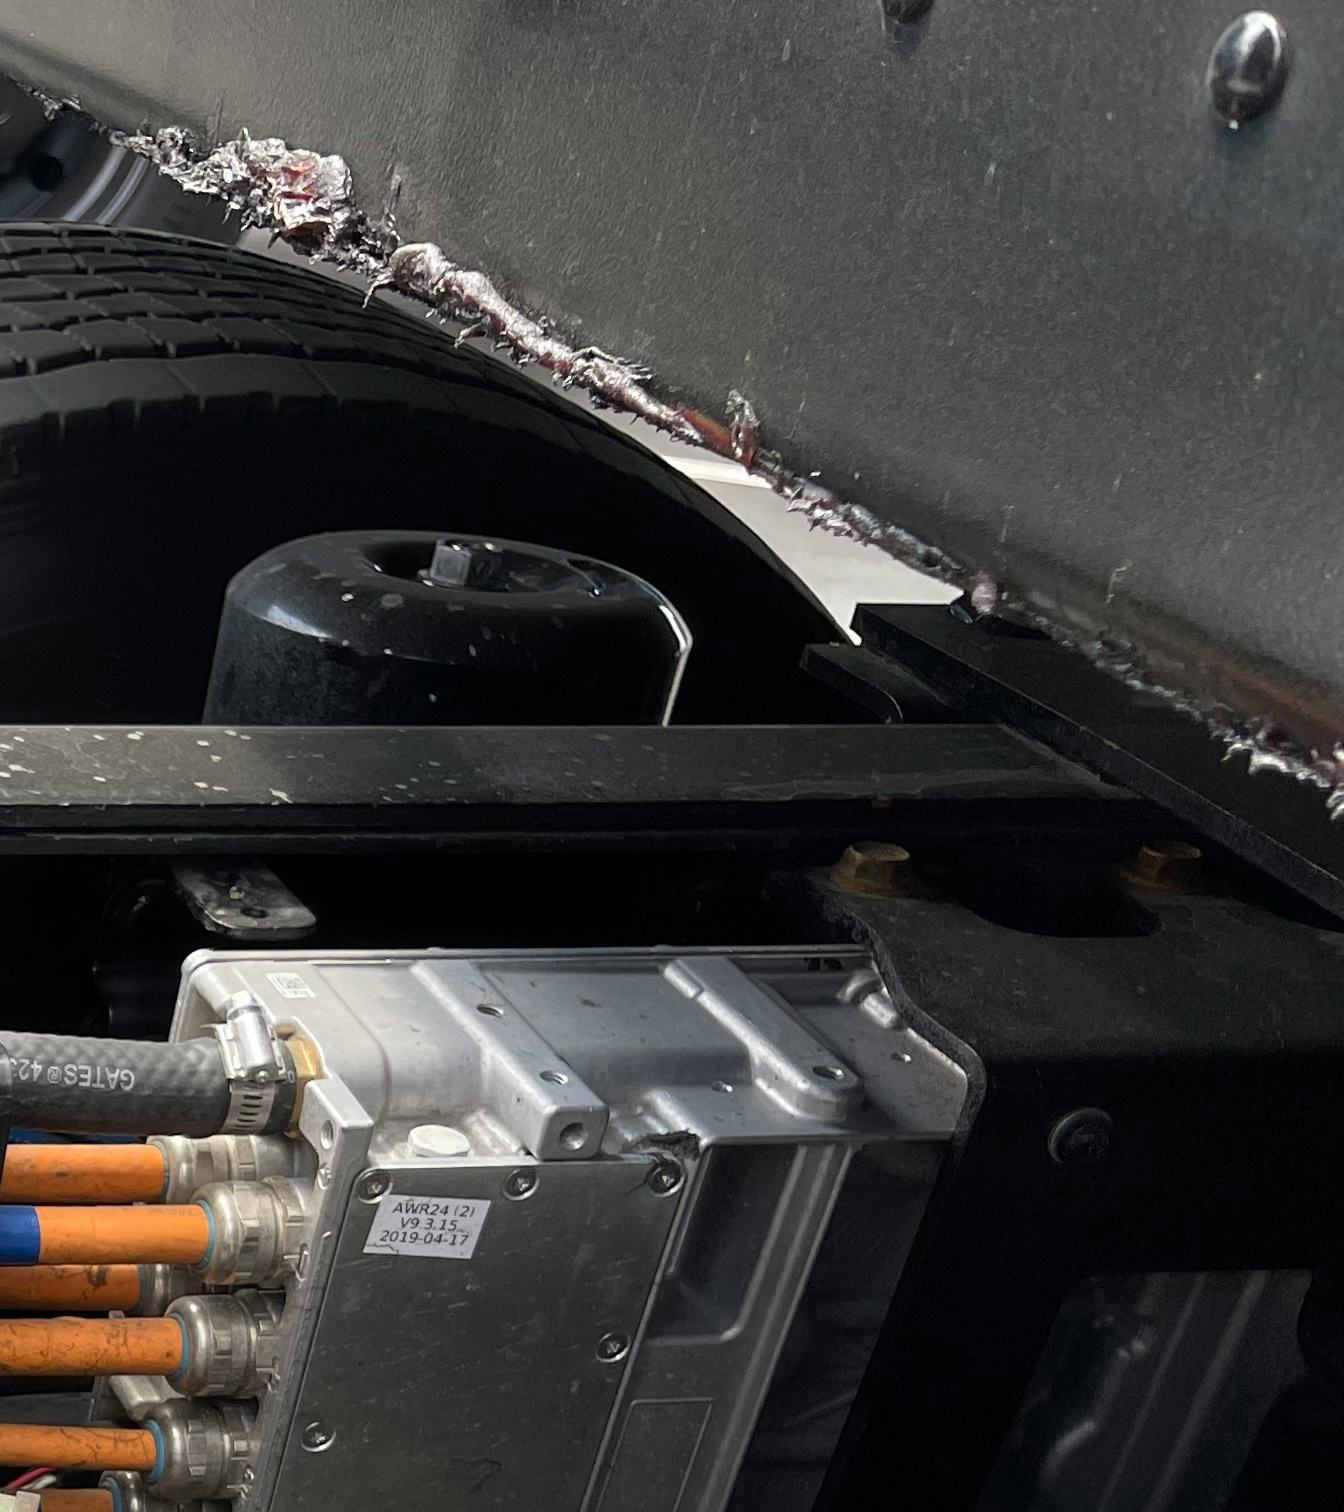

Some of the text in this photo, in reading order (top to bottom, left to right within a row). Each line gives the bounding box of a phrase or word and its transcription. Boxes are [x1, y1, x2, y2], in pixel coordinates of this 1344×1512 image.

[392, 1201, 476, 1219] AWR24 (2)
[378, 1229, 470, 1247] 2019-04-17
